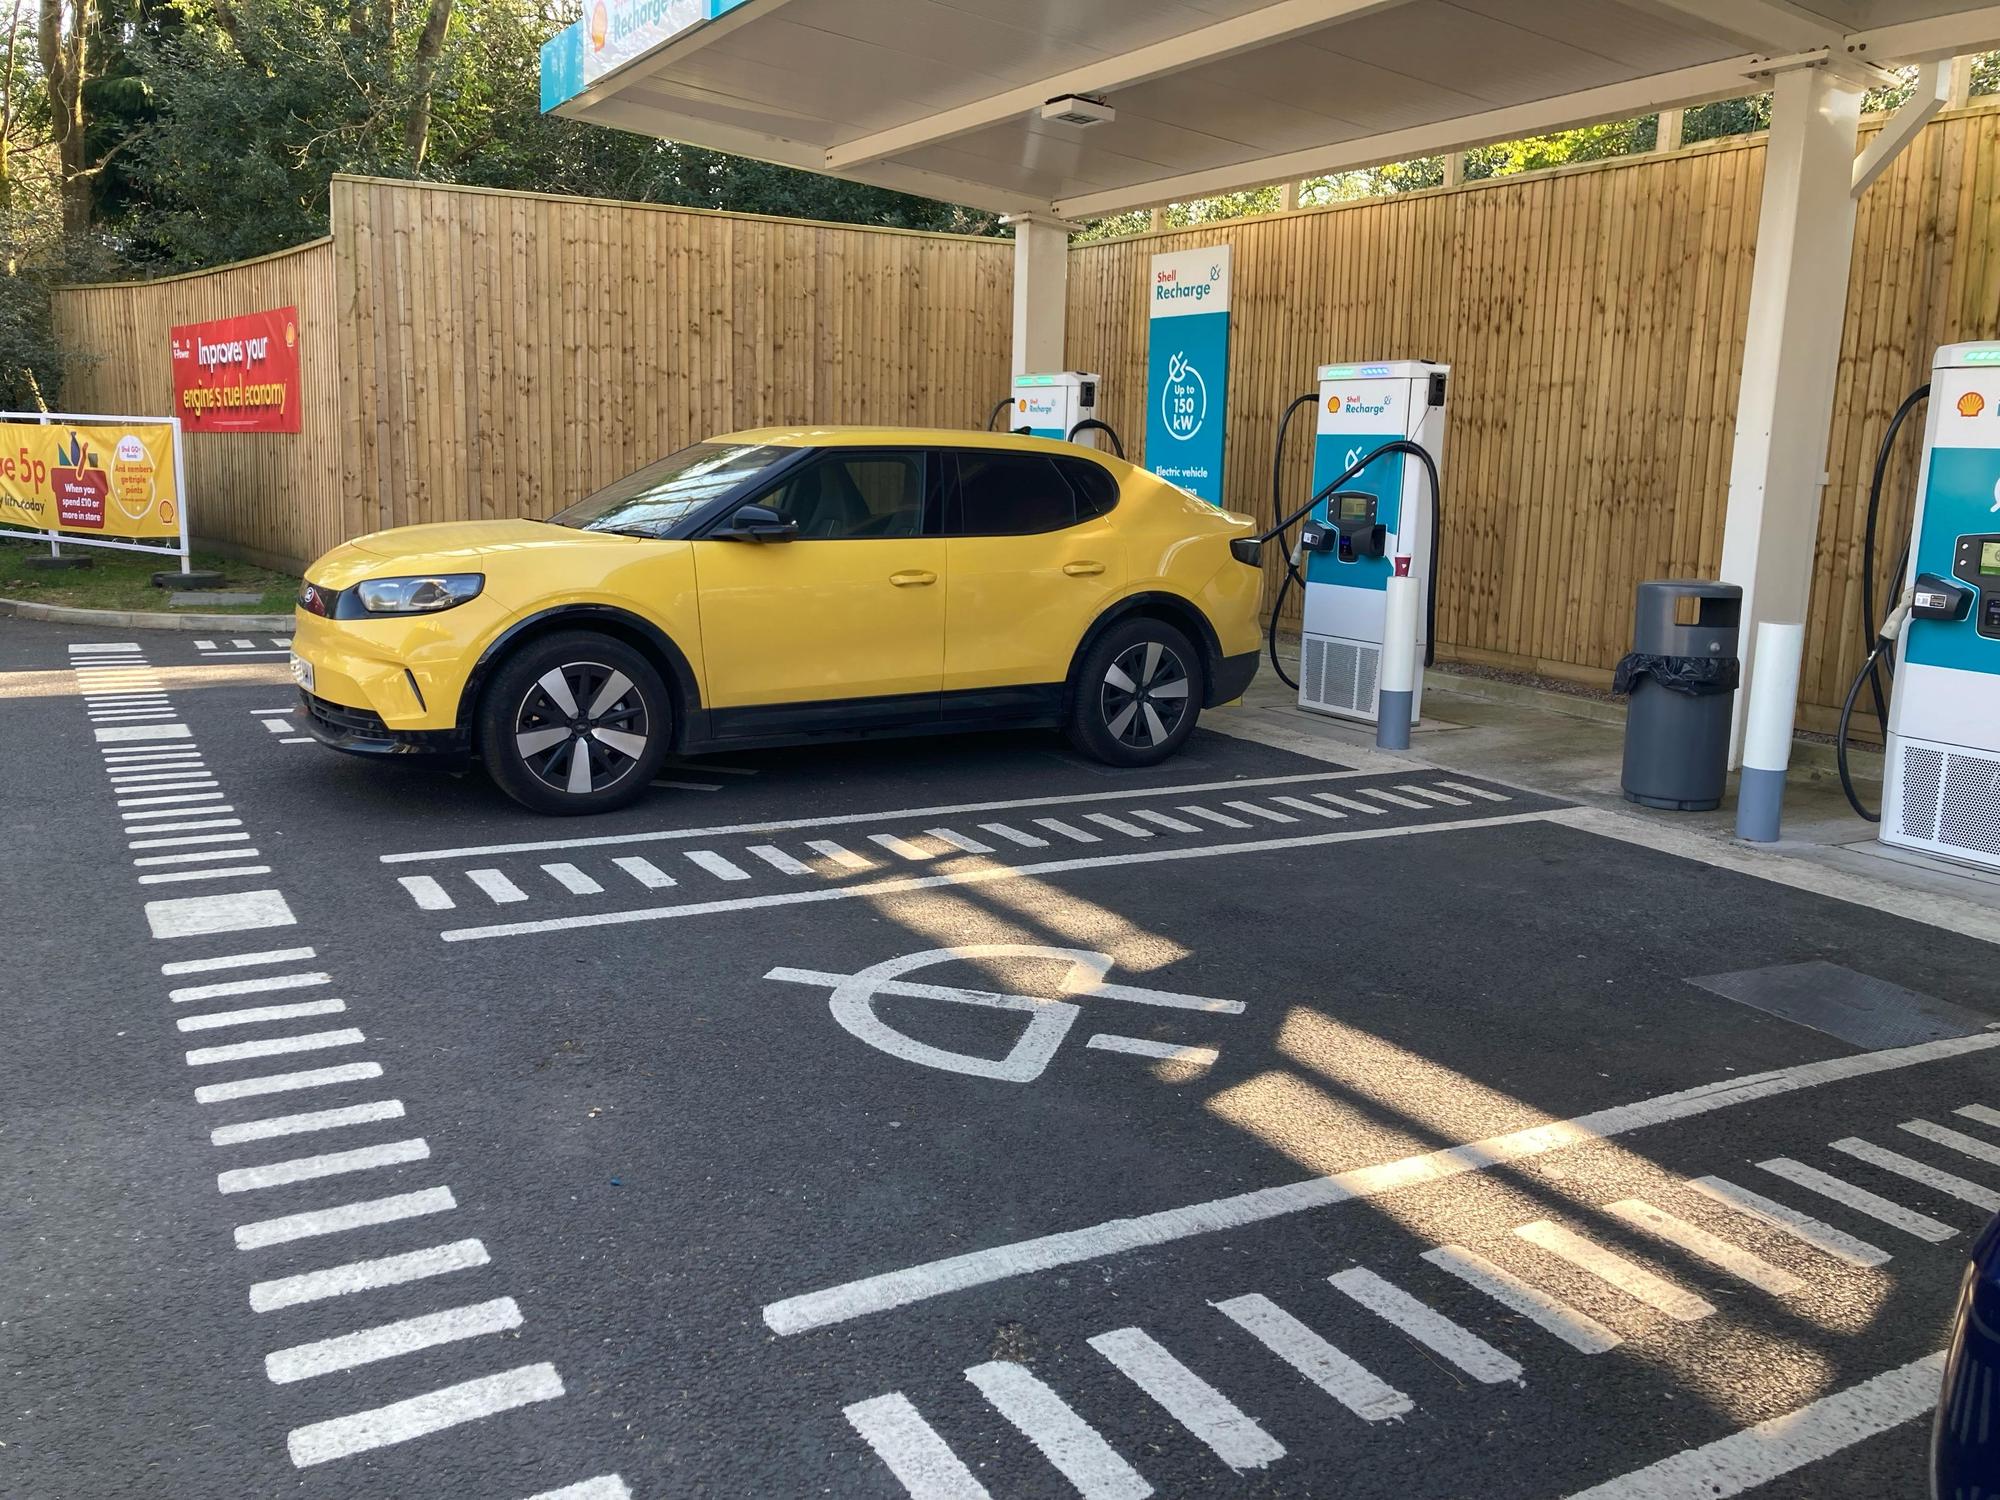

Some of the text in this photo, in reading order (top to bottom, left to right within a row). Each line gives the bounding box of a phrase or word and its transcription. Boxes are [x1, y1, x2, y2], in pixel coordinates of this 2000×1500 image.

[1158, 270, 1176, 282] Shell
[1157, 282, 1210, 300] Recharge
[197, 336, 268, 373] Improves your
[1174, 385, 1195, 397] Up to
[244, 381, 287, 415] economy
[1346, 395, 1360, 403] Shell
[1174, 398, 1194, 413] 150
[1346, 403, 1384, 415] Recharge
[1173, 414, 1193, 430] kW
[20, 448, 45, 494] 5p
[1156, 465, 1208, 478] Electric vehicle
[64, 483, 95, 496] When you
[62, 497, 80, 508] spend
[81, 497, 92, 507] £10
[62, 511, 78, 520] more
[78, 510, 85, 519] in
